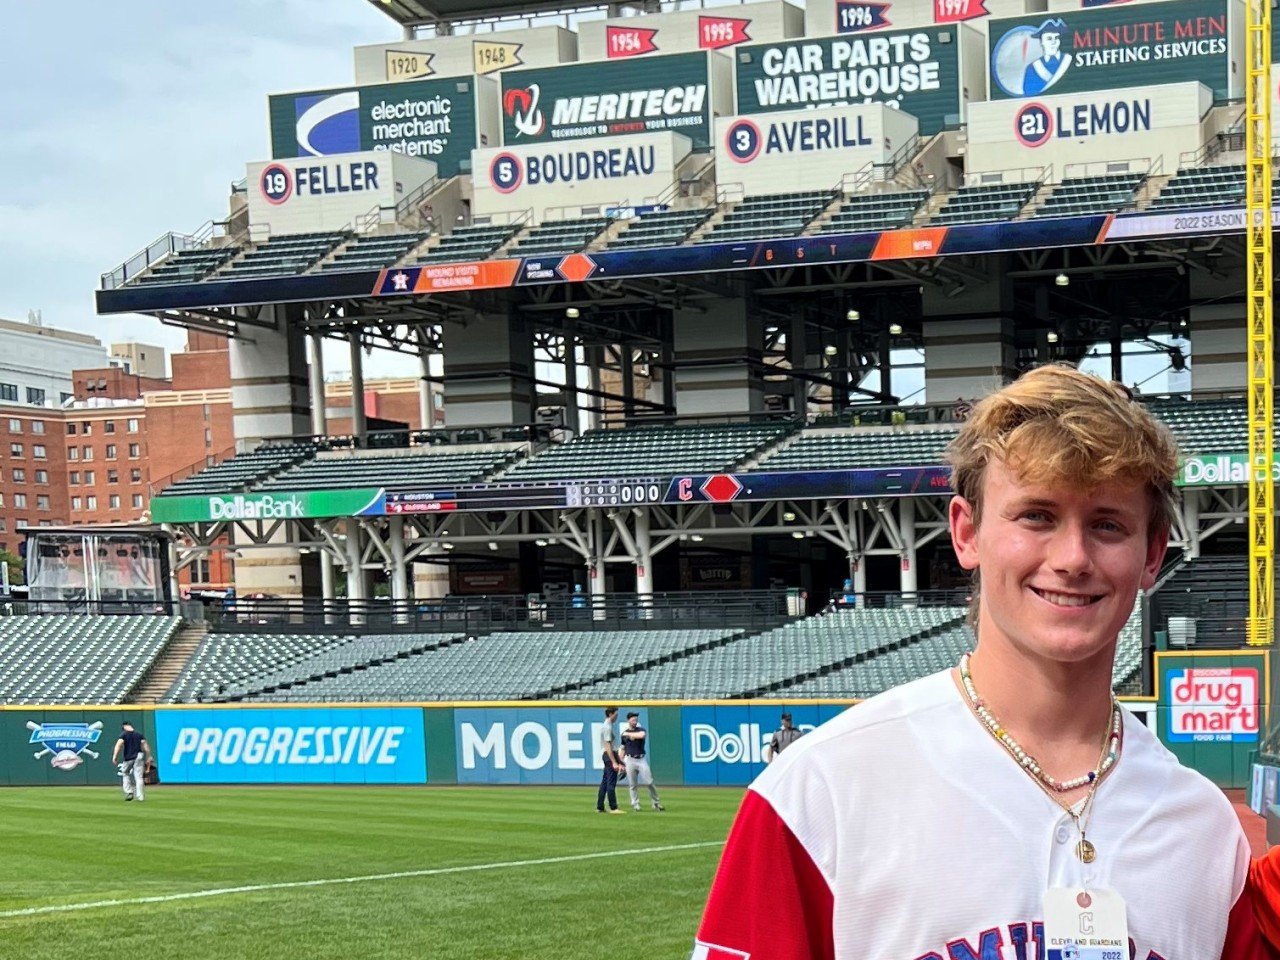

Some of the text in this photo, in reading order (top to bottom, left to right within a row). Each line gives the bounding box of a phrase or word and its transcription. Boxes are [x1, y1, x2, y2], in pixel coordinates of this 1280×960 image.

[840, 7, 873, 27] 1996
[938, 0, 970, 16] 1997
[611, 34, 641, 51] 1954
[703, 23, 734, 42] 1995
[1073, 15, 1226, 49] MINUTE MEN
[391, 57, 418, 75] 1920
[478, 47, 505, 66] 1948
[762, 32, 931, 77] CAR PARTS
[1075, 38, 1226, 68] STAFFING SERVICES
[754, 61, 940, 107] WAREHOUSE
[371, 94, 451, 121] electronic
[552, 84, 707, 125] MERITECH
[372, 115, 451, 140] merchant
[1021, 98, 1150, 139] 21 LEMON
[736, 115, 872, 154] 3 AVERILL
[265, 161, 380, 196] 19 FELLER
[499, 145, 656, 185] 5 BOUDREAU
[1173, 215, 1200, 230] 2022
[1201, 212, 1243, 228] SEASON
[208, 494, 303, 519] DollarBank
[1175, 668, 1242, 710] drug
[1182, 707, 1260, 732] mart
[36, 729, 93, 739] PROGRESSIVE
[171, 726, 405, 765] PROGRESSIVE
[690, 722, 776, 765] Dolla
[1102, 951, 1122, 960] 2022
